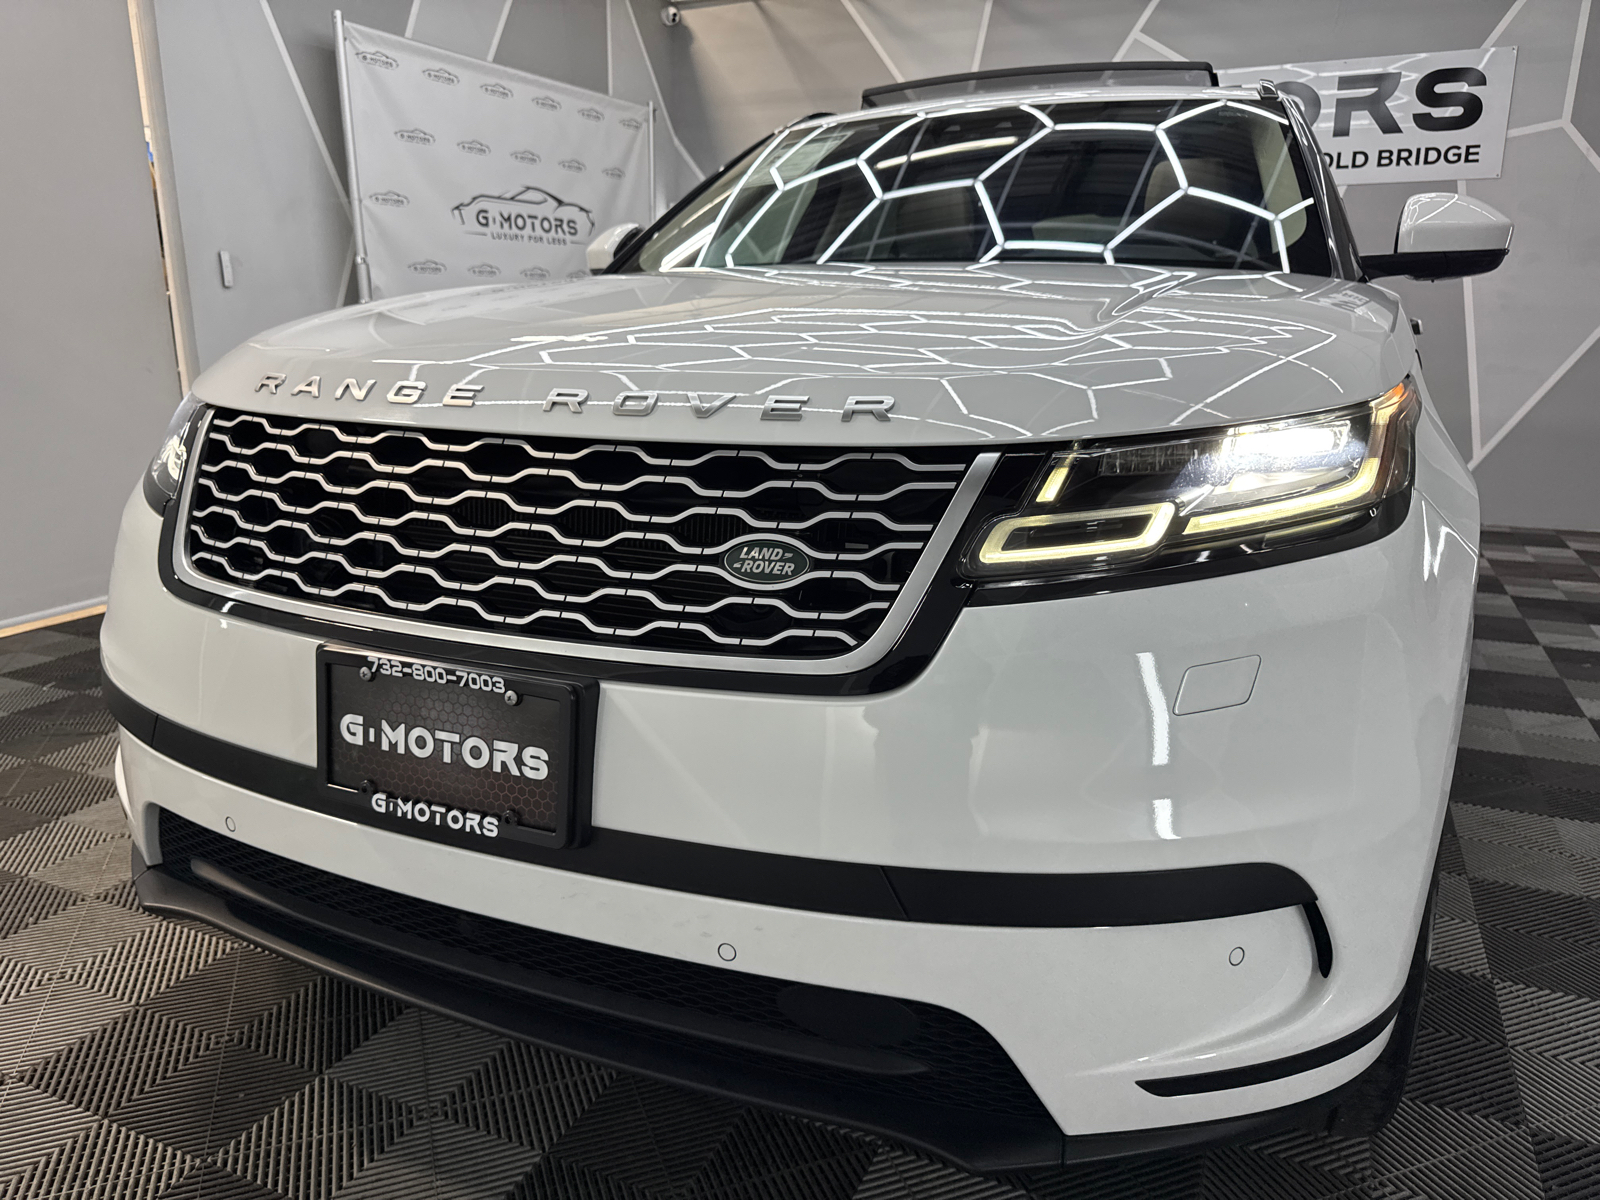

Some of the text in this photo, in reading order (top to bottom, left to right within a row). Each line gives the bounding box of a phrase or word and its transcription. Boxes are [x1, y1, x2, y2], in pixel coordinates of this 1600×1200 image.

[1376, 144, 1481, 167] BRIDGE
[491, 231, 567, 246] LUXURY FOR LESS
[254, 371, 898, 424] RANGE ROVER
[739, 546, 783, 560] LAND
[741, 560, 795, 575] ROVER
[367, 656, 506, 694] 732-800-7003
